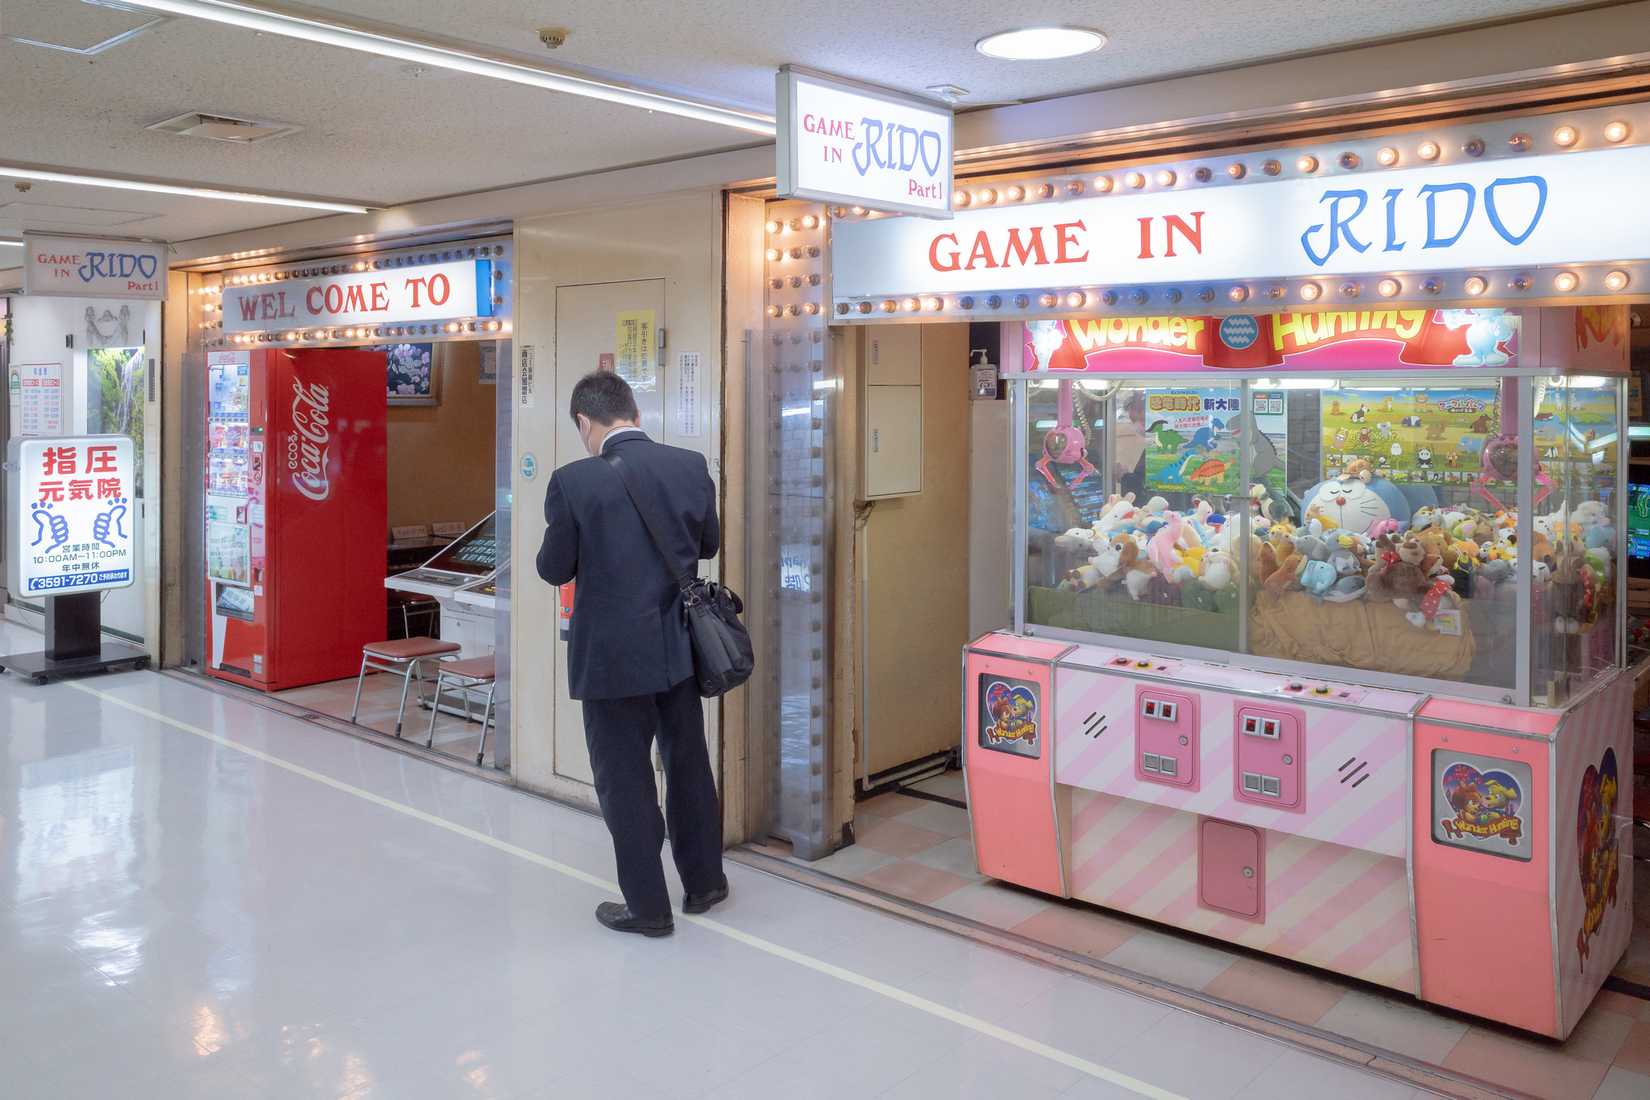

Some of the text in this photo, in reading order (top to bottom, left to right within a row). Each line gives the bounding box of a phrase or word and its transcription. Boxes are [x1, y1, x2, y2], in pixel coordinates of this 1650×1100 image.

[803, 114, 855, 140] GAME
[824, 146, 842, 163] IN
[852, 117, 942, 177] RIDO
[928, 175, 1548, 272] GAME IN RIDO
[37, 253, 81, 265] GAME
[78, 251, 158, 283] RIDO
[54, 268, 70, 278] IN
[238, 273, 450, 321] WEL COME TO
[292, 375, 329, 501] Coca-Cola
[42, 445, 118, 476] 指圧
[38, 478, 122, 502] 元気院
[62, 542, 100, 553] 営業時間
[62, 562, 100, 572] 年中無休
[38, 573, 98, 588] 3591-7270
